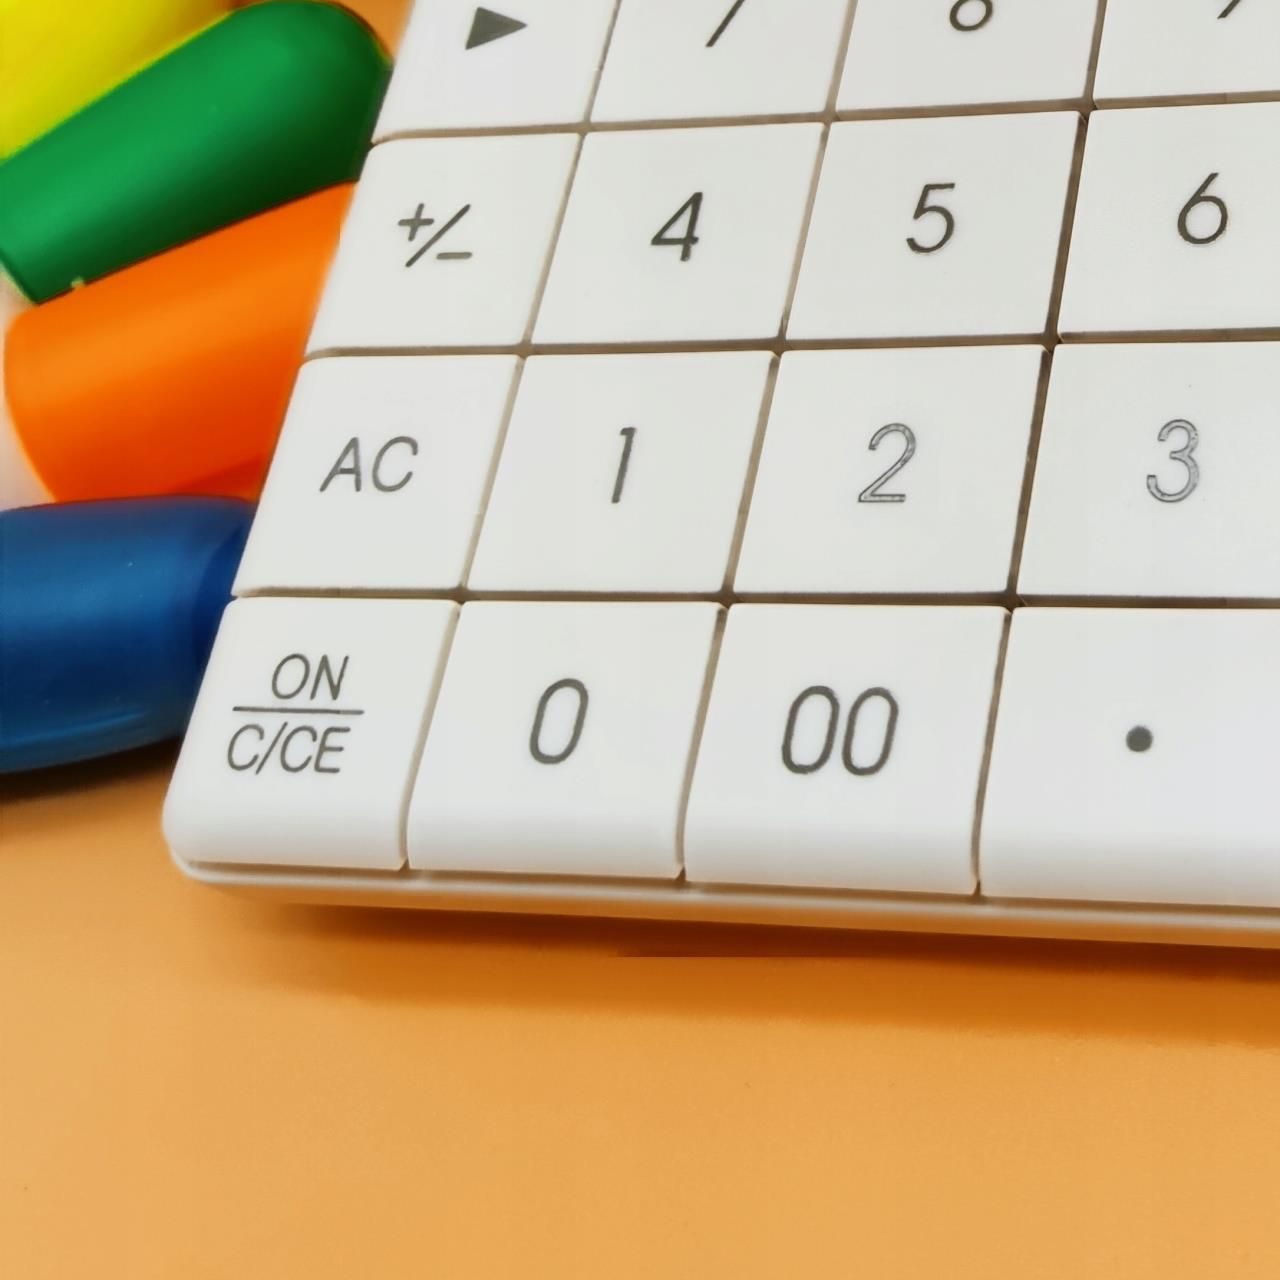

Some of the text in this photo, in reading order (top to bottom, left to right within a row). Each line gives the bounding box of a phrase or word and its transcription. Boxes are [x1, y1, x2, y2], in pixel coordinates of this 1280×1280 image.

[649, 191, 704, 263] 4
[905, 181, 957, 256] 5
[1176, 171, 1230, 246] 6
[319, 435, 419, 498] AC
[610, 426, 638, 505] 1
[856, 422, 917, 504] 2
[1145, 418, 1200, 504] 3
[271, 652, 350, 702] ON
[226, 721, 352, 776] C/CE
[528, 677, 590, 766] 0
[780, 684, 900, 778] 00
